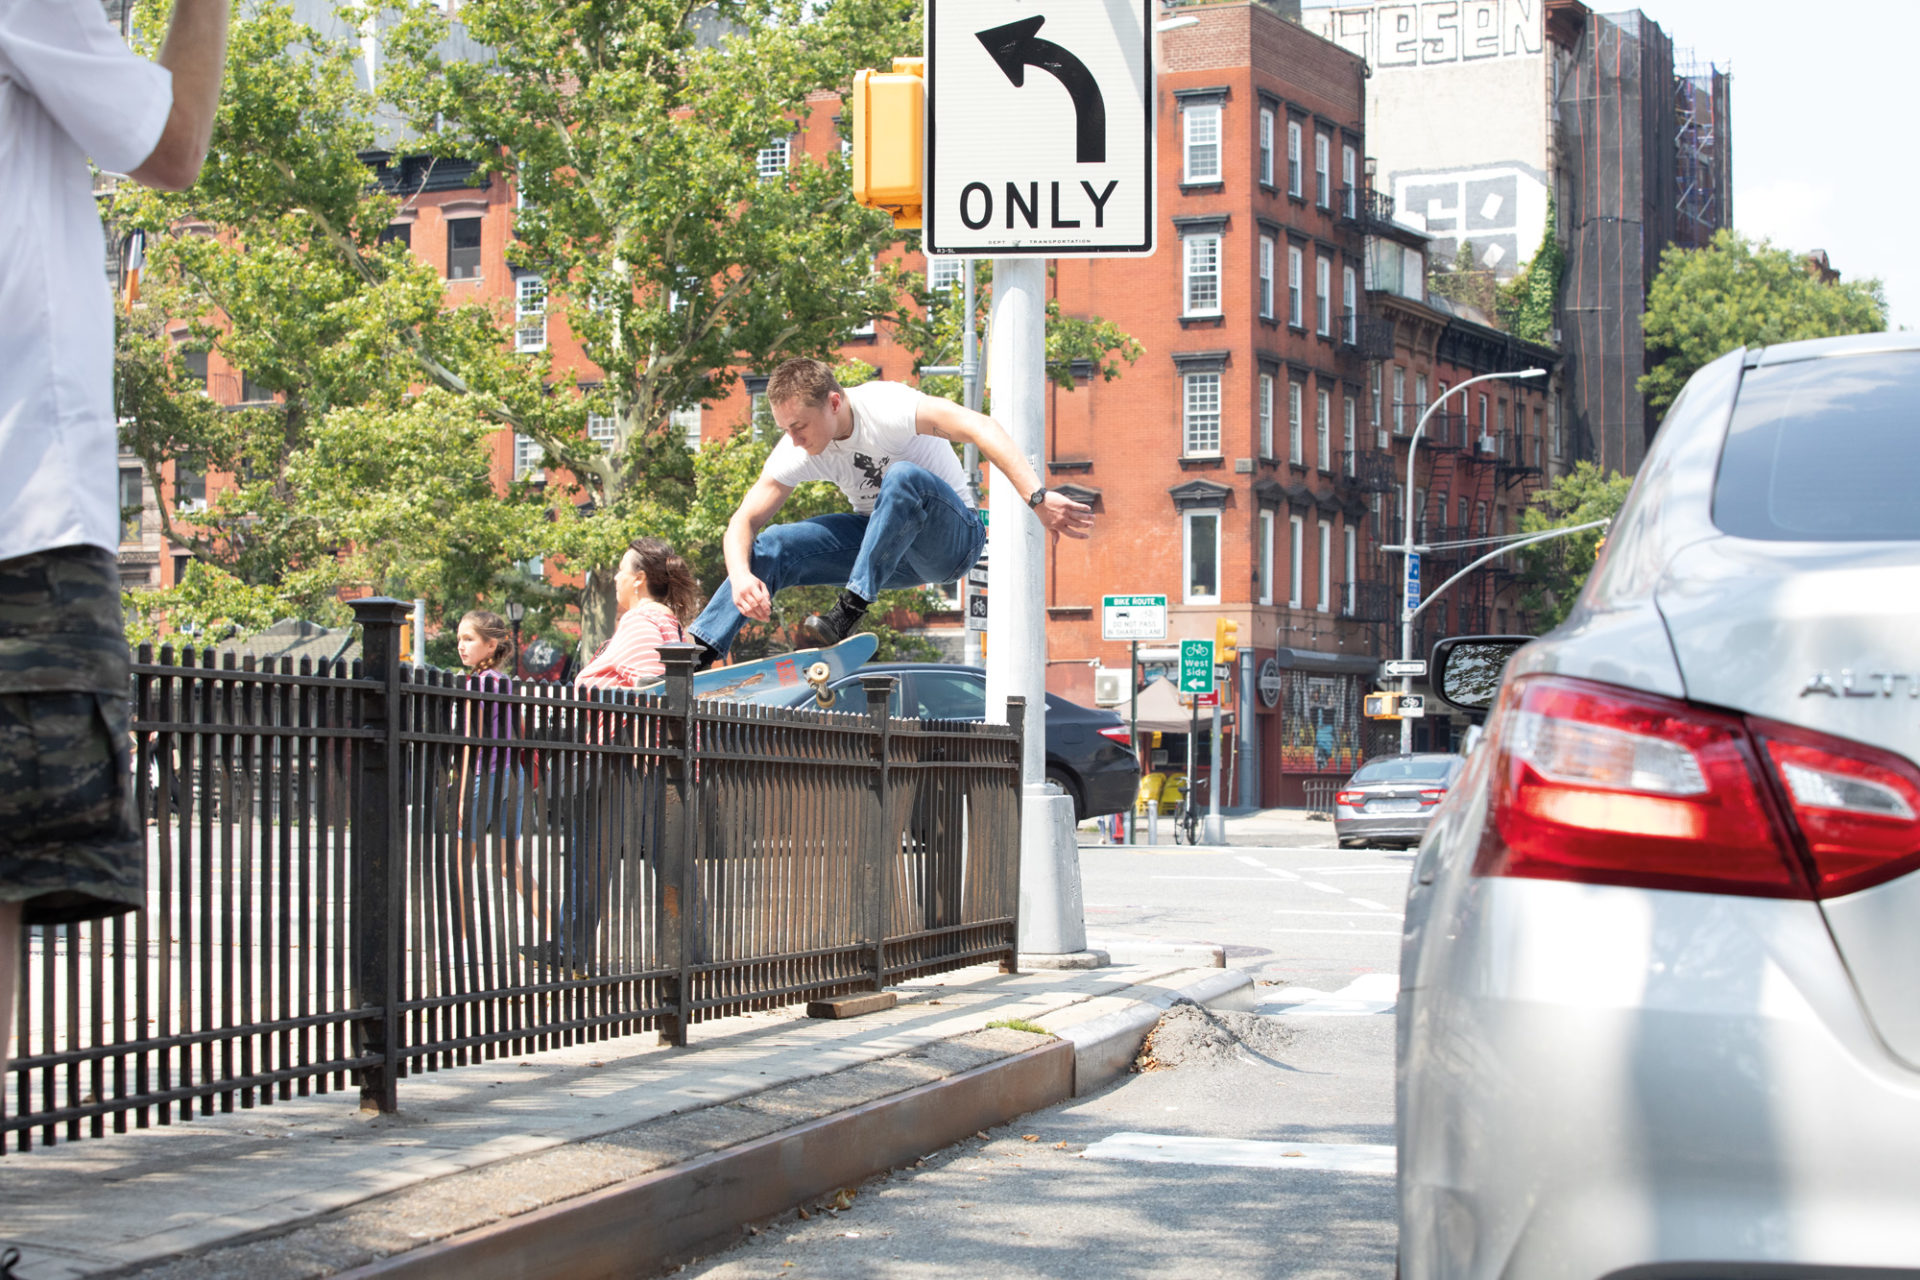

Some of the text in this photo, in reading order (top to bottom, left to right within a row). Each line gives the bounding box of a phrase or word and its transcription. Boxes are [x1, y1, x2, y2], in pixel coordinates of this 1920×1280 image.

[959, 180, 1119, 231] ONLY
[1113, 598, 1130, 606] BIKE
[1185, 659, 1209, 667] West
